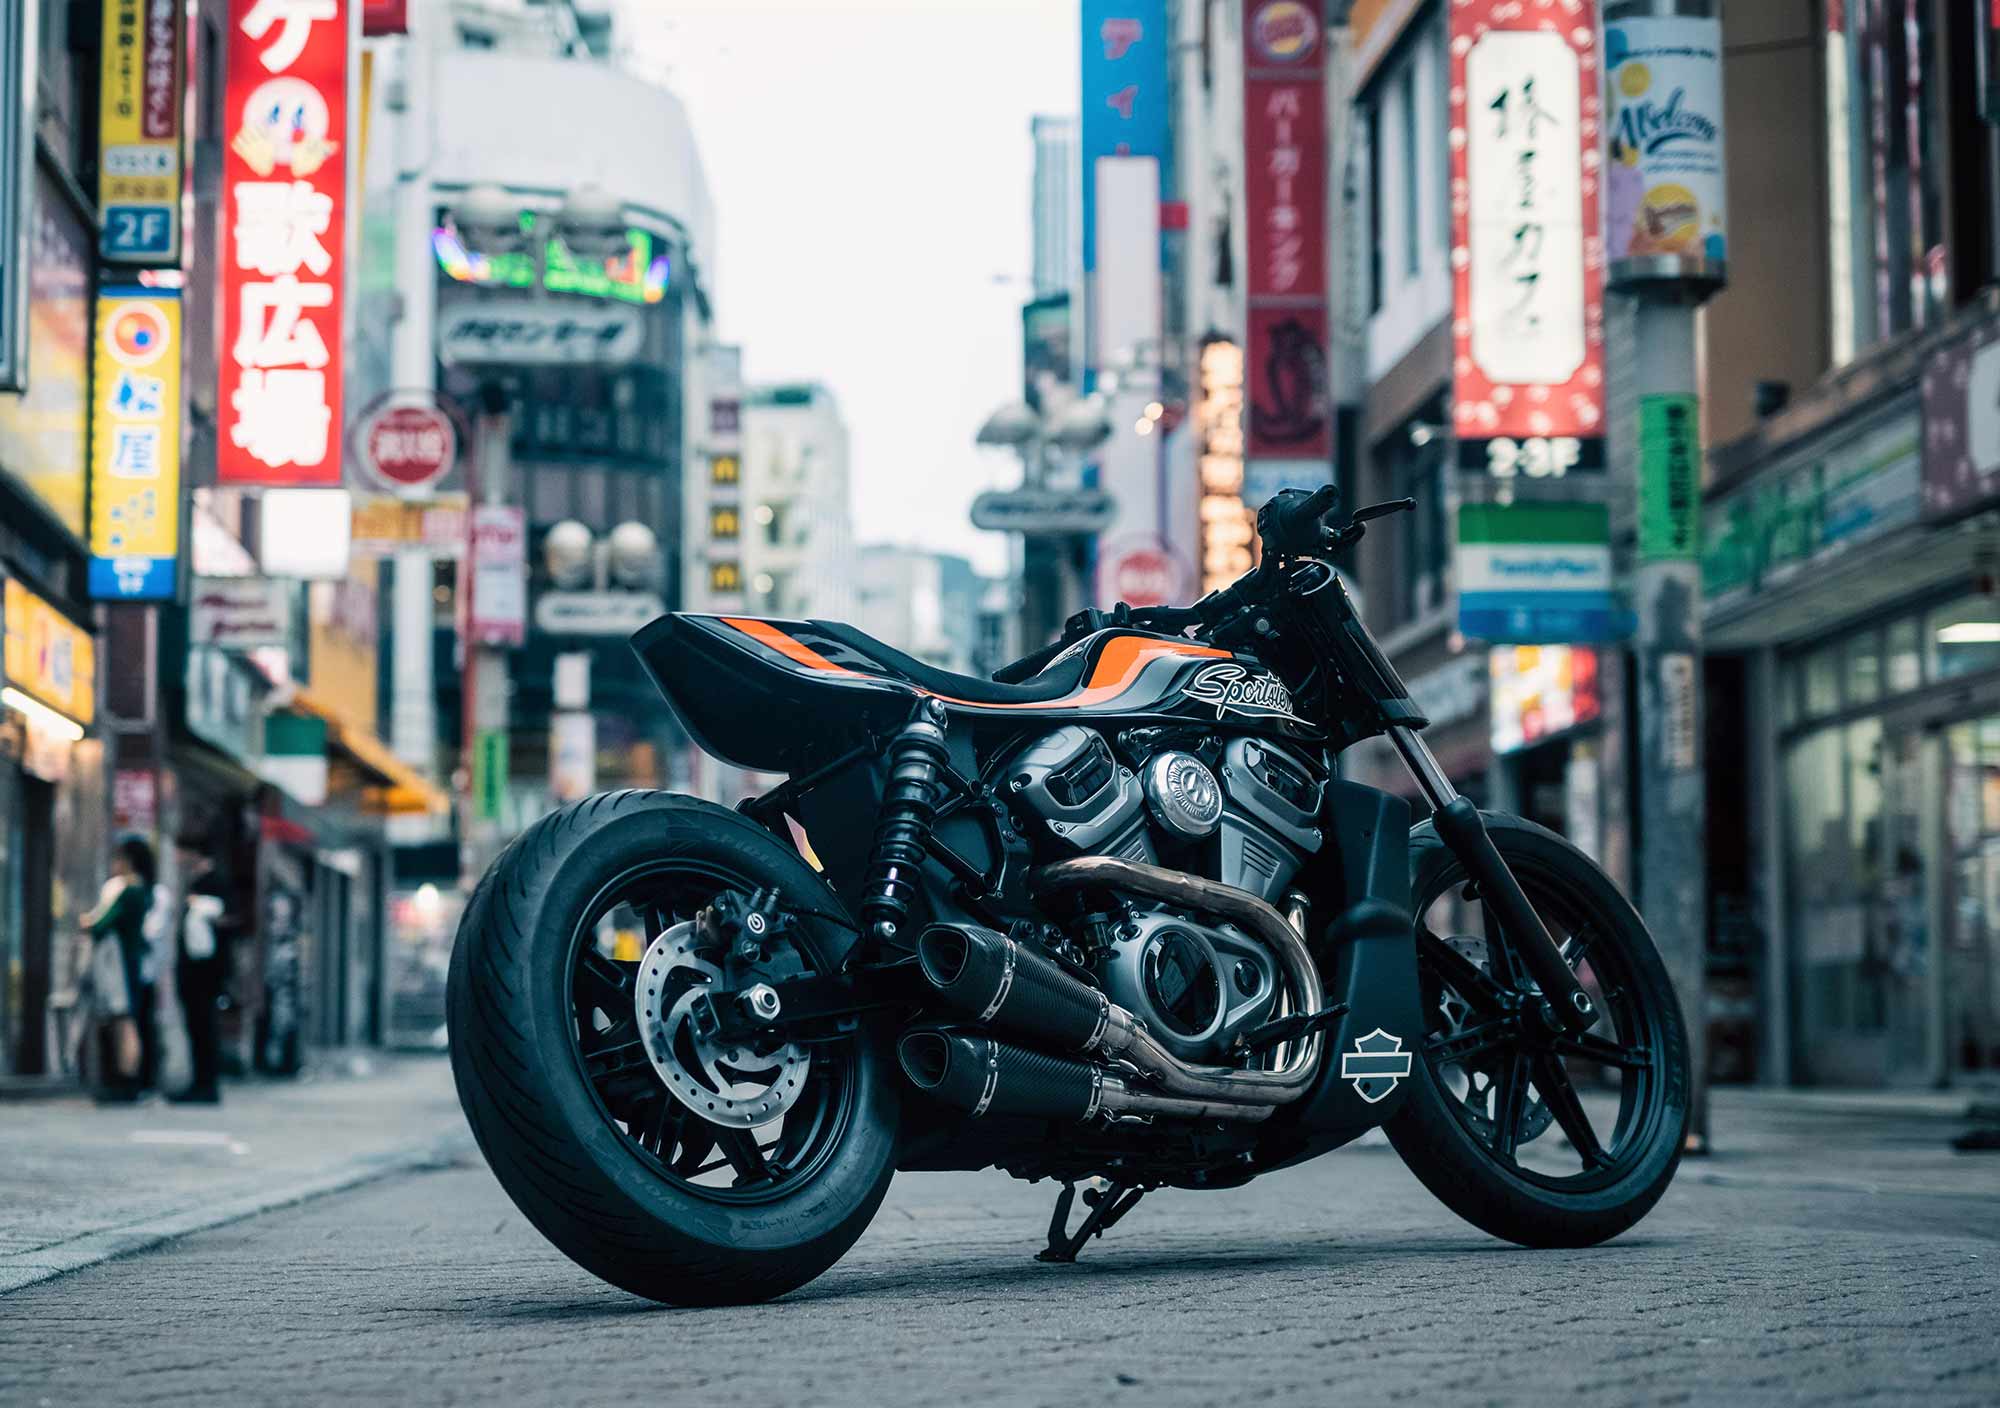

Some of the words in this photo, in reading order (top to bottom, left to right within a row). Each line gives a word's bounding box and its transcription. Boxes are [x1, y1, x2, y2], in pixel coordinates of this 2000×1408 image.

[114, 213, 164, 247] 2F
[231, 181, 334, 467] 歌広場
